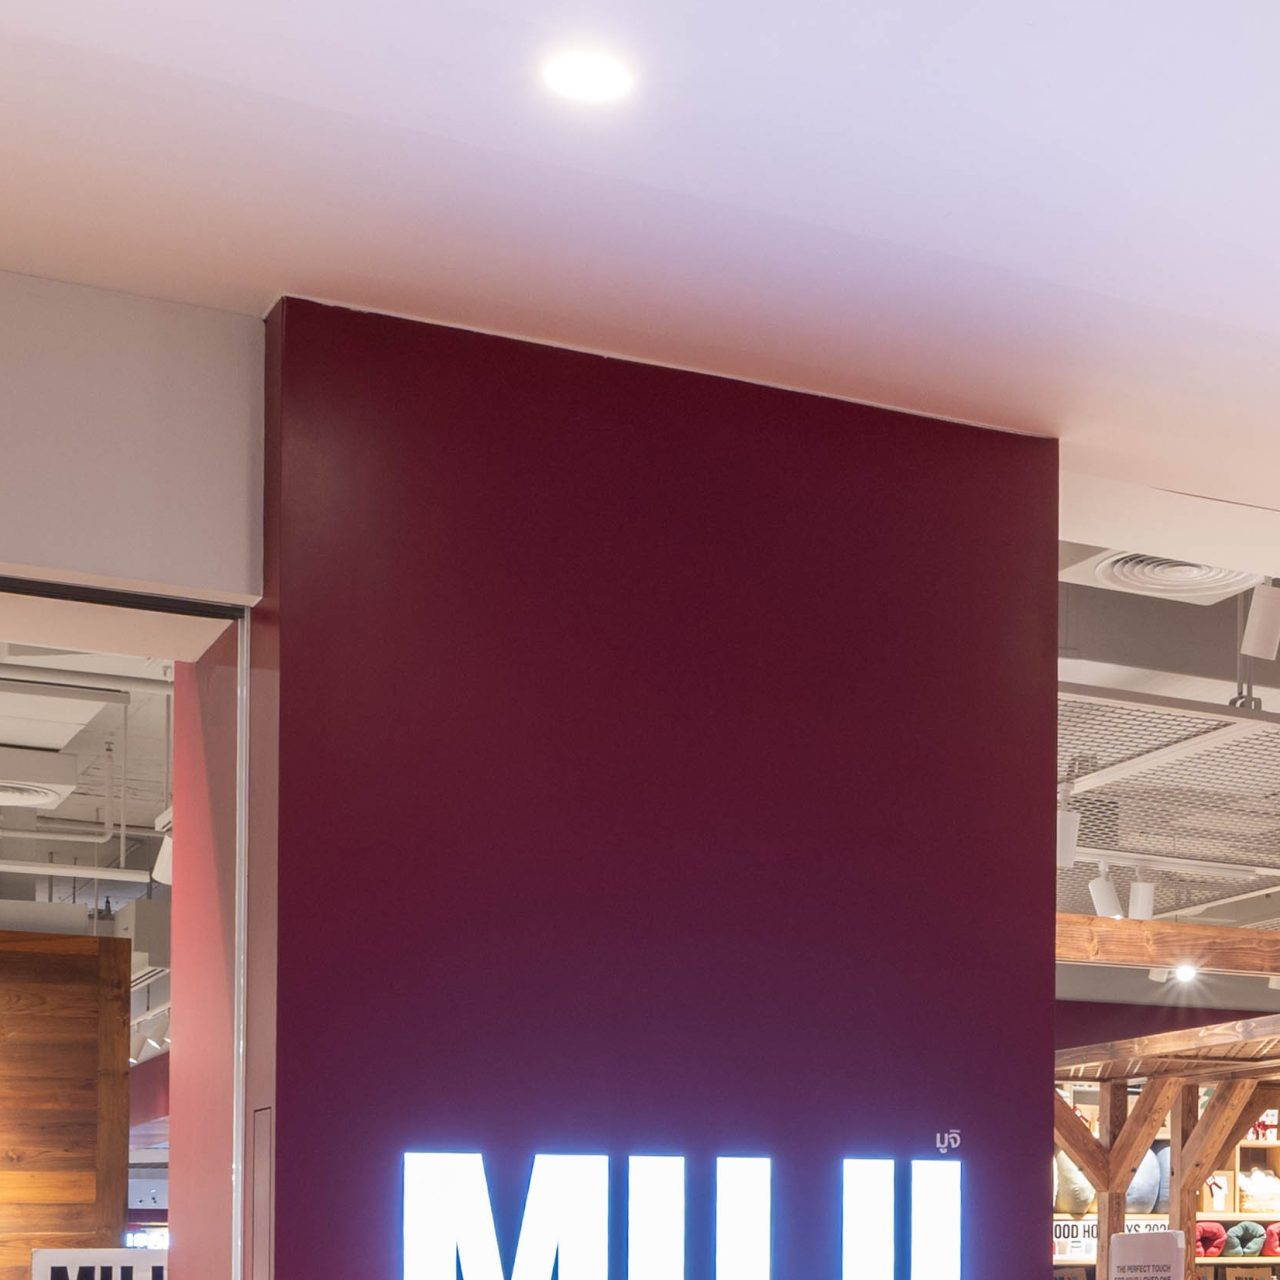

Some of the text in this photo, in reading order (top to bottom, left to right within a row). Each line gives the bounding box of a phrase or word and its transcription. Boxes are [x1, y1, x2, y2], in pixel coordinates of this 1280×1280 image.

[936, 1129, 961, 1154] มูจิ
[1054, 1223, 1079, 1239] OOD
[1116, 1264, 1171, 1273] THE PERFECT TOUCH
